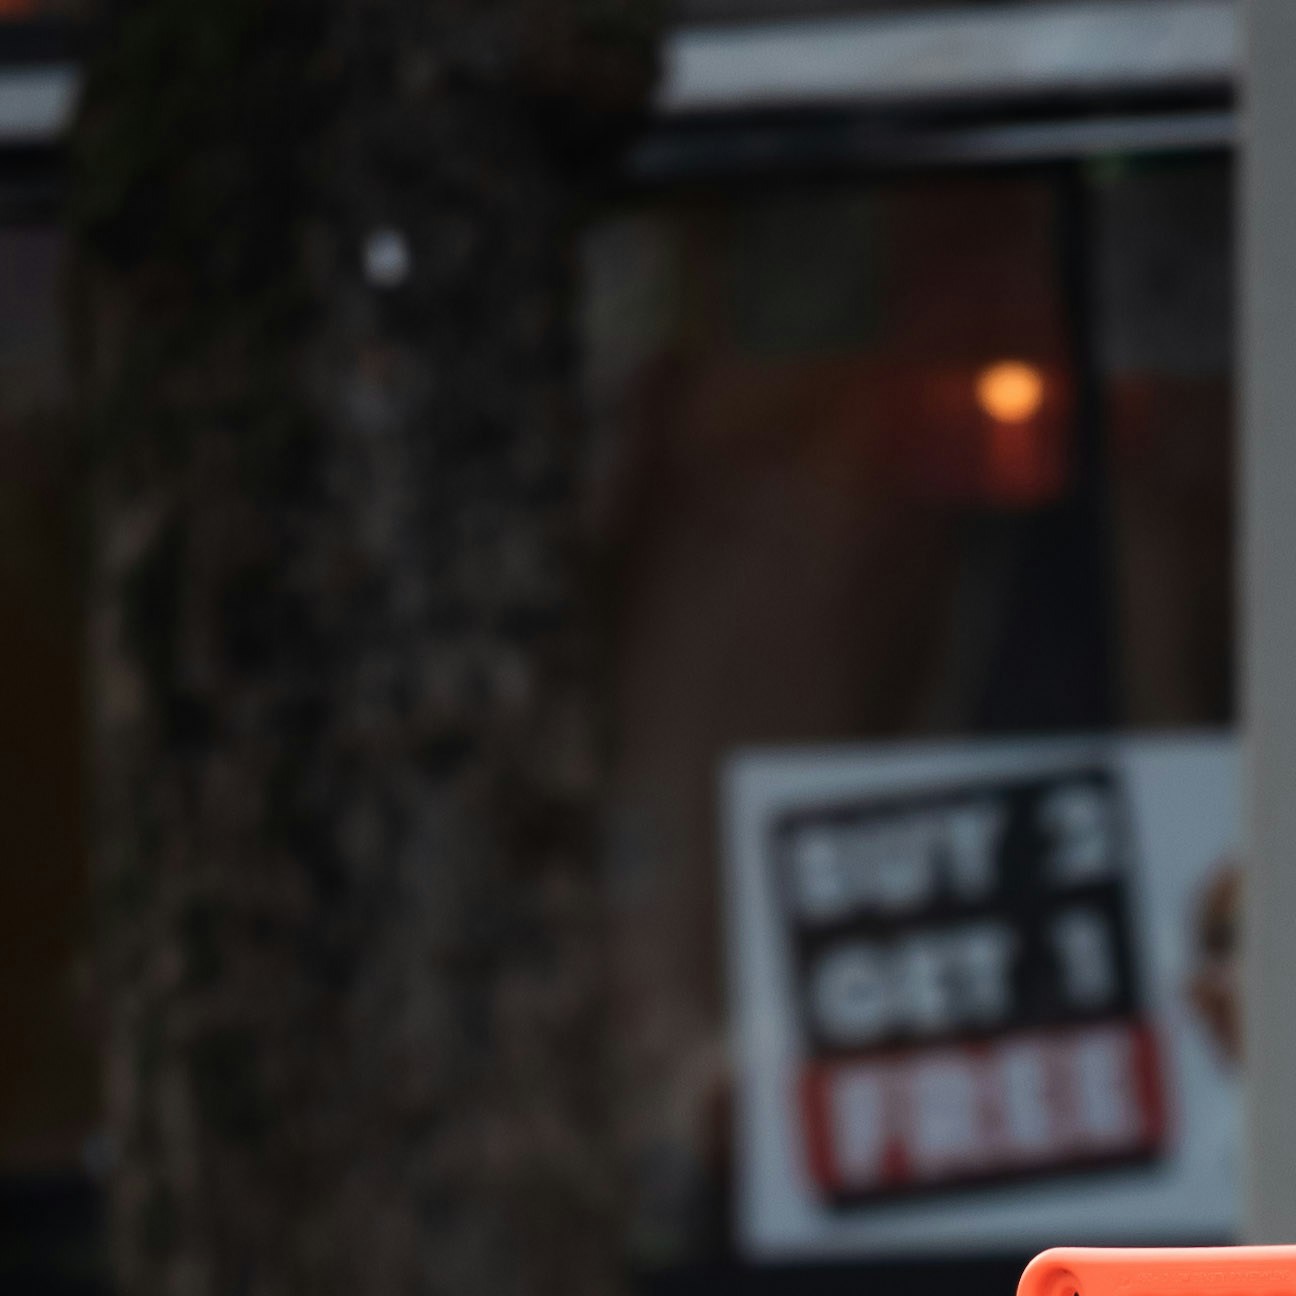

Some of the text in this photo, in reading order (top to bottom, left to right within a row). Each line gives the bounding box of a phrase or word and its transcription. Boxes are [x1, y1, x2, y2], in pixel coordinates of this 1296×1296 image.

[784, 800, 1004, 918] BUY
[813, 904, 1114, 1043] GET 1
[829, 1025, 1146, 1185] FREE
